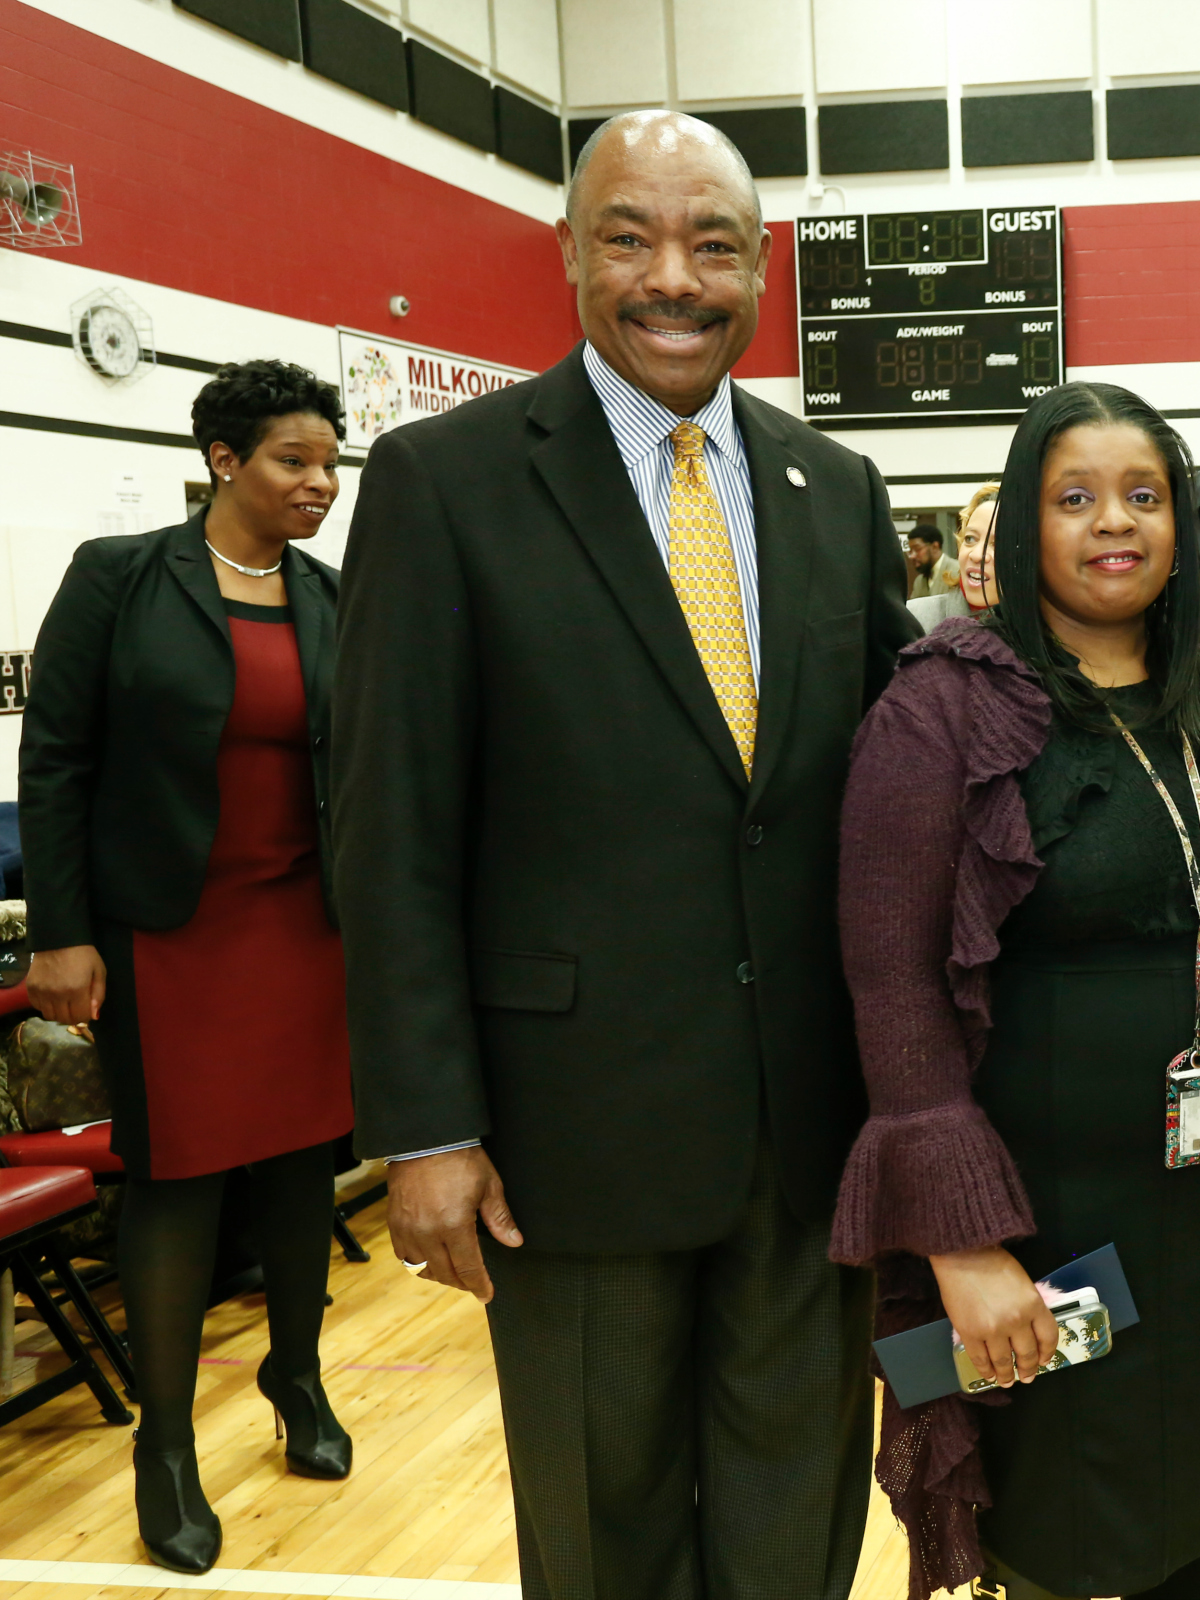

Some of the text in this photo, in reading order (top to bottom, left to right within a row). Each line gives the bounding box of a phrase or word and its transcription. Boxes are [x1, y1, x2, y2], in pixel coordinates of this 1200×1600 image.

[989, 210, 1054, 233] GUEST
[800, 220, 857, 242] HOME
[908, 265, 947, 276] PERIOD
[830, 296, 871, 310] BONUS
[984, 290, 1026, 304] BONUS
[1021, 321, 1054, 334] BOUT
[807, 330, 838, 343] BOUT
[805, 392, 841, 405] WON
[911, 388, 951, 402] GAME
